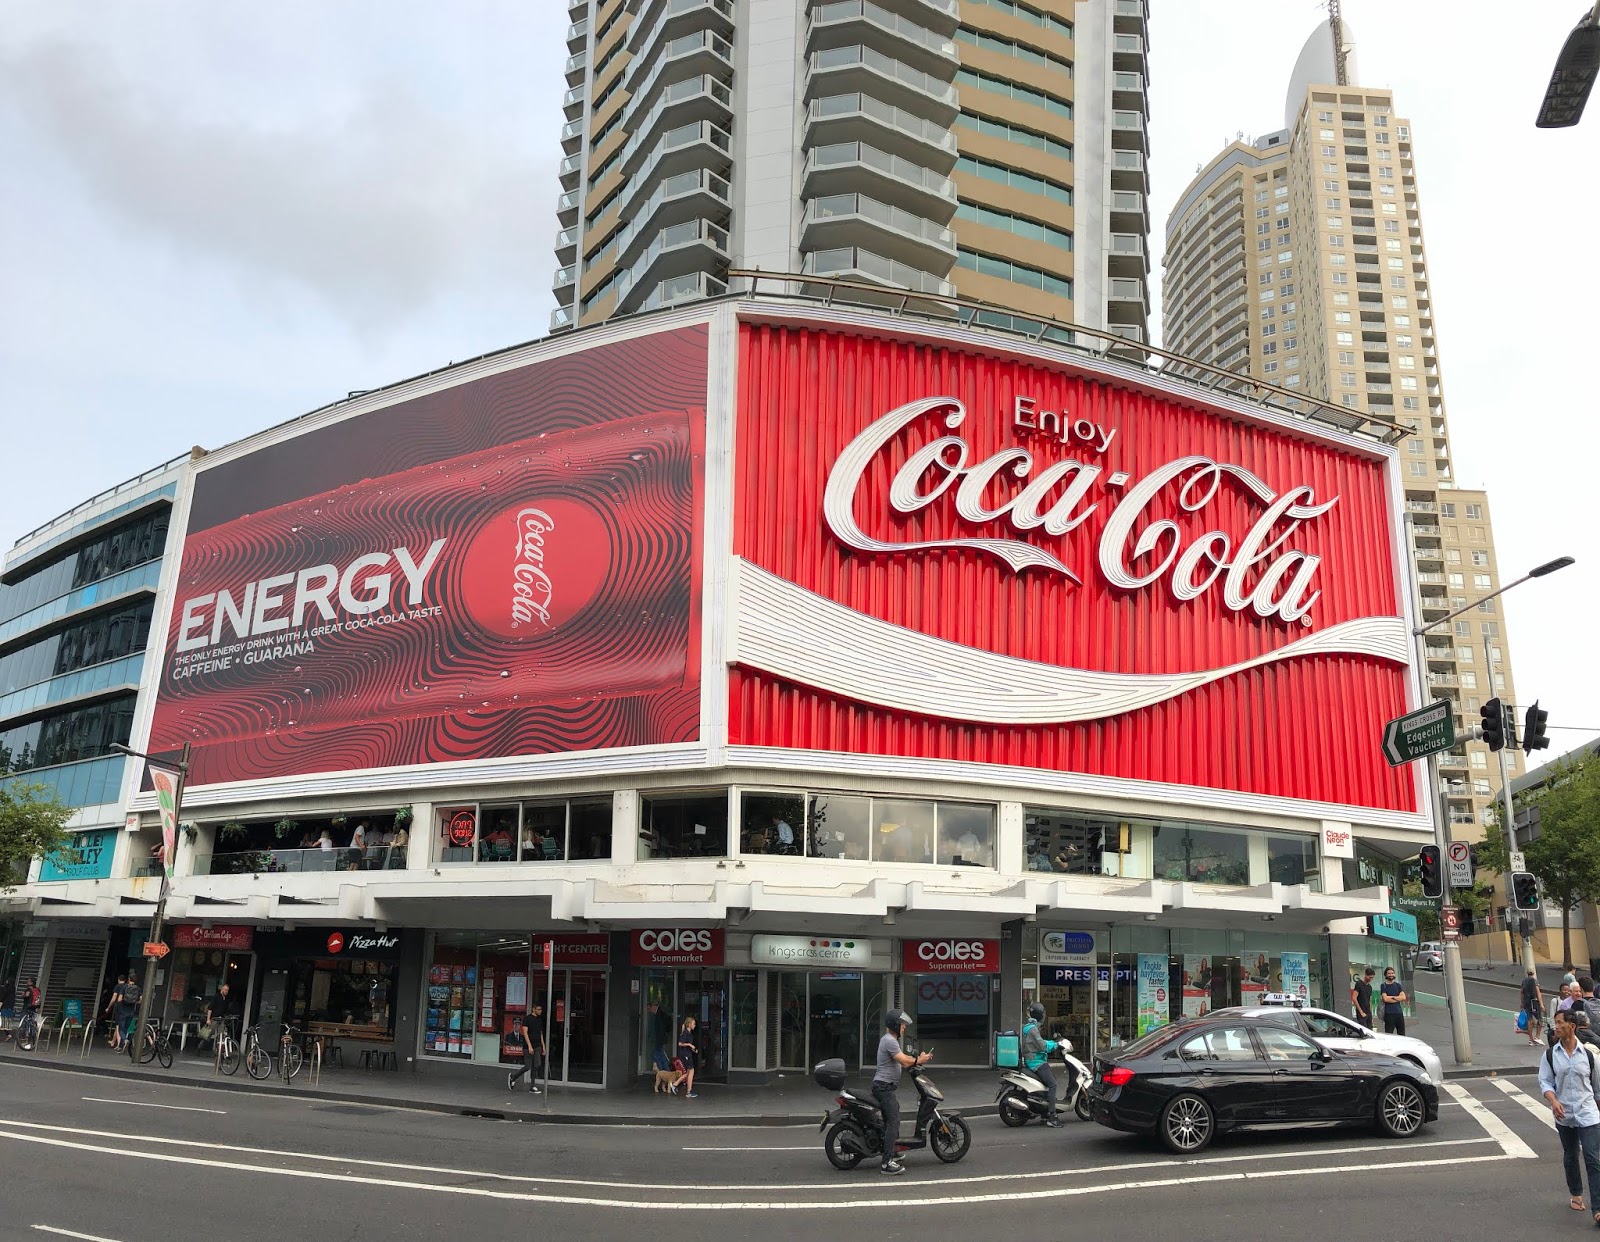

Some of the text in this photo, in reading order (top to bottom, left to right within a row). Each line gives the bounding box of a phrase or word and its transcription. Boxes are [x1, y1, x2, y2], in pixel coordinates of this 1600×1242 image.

[1014, 395, 1117, 452] Enjoy
[824, 396, 1340, 623] Coca-Cola
[512, 508, 555, 627] Coca-Cola
[176, 538, 447, 653] ENERGY
[175, 606, 442, 666] THE ONLY ENERGY DRINK WITH A GREAT COCA-COLA TASTE
[172, 640, 314, 680] CAFFEINE GUARANA
[1404, 709, 1445, 730] KINGS CROSS RD
[1406, 722, 1444, 744] Edgecliff
[1408, 737, 1446, 756] Vaucluse
[1326, 830, 1350, 840] Claude
[1327, 837, 1344, 845] Neon
[348, 935, 399, 949] Pizza Hut
[534, 944, 607, 953] FLHT CENTRE
[640, 928, 713, 951] coles
[652, 954, 703, 964] Supermarket
[769, 945, 851, 959] kings cross centre
[918, 940, 985, 960] coles
[928, 962, 975, 971] Supermarket
[1143, 961, 1162, 971] Tackle
[1286, 959, 1302, 968] Tackle
[1141, 970, 1165, 979] hayfever
[1148, 977, 1165, 986] faster
[919, 976, 987, 1001] coles
